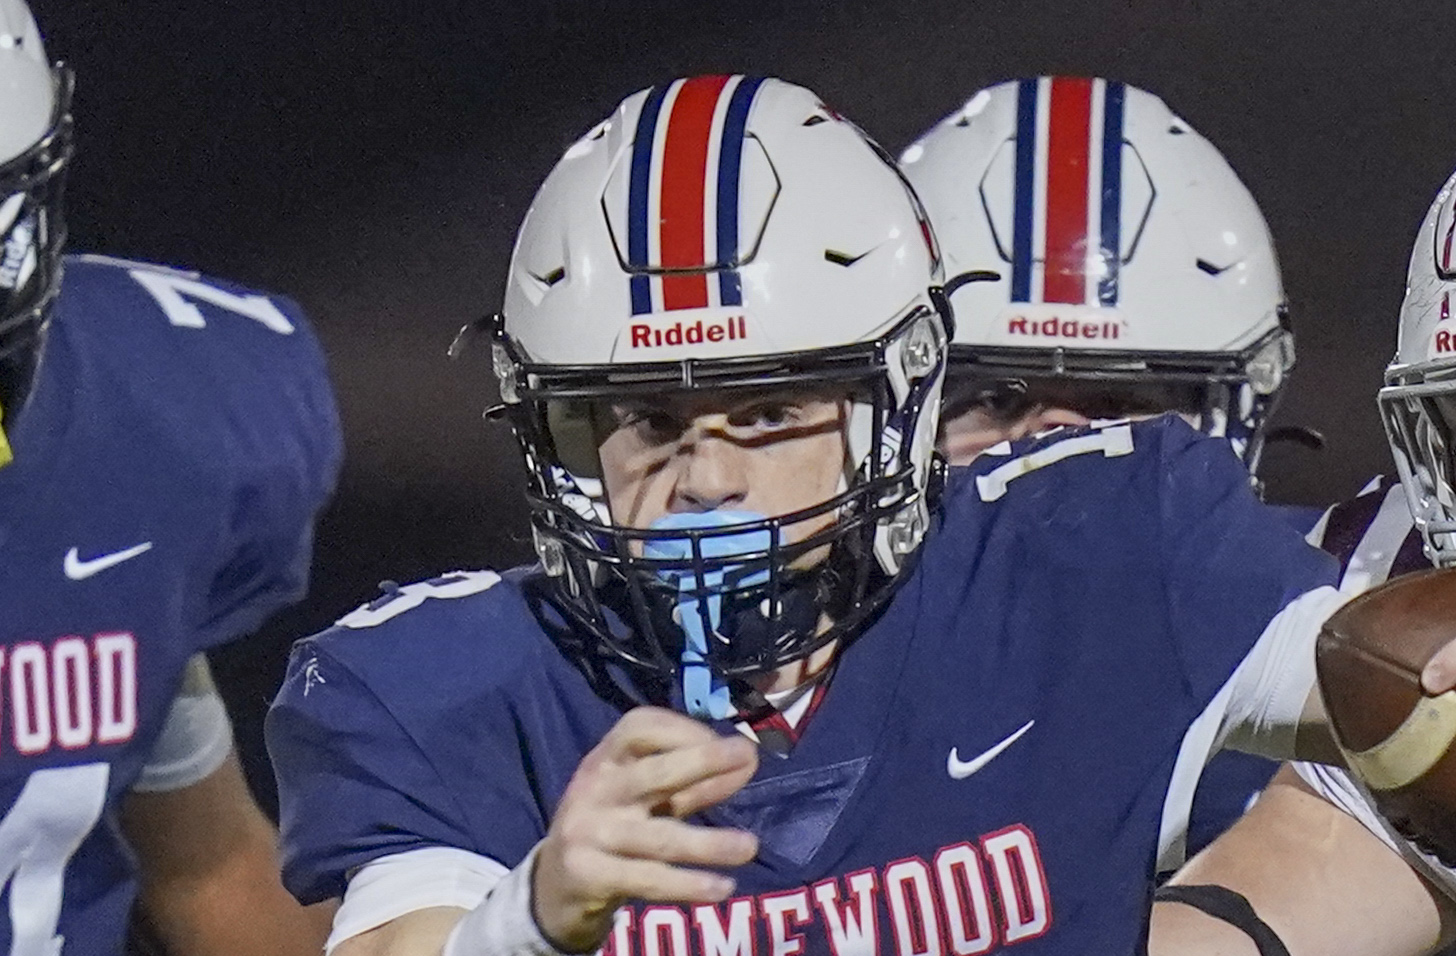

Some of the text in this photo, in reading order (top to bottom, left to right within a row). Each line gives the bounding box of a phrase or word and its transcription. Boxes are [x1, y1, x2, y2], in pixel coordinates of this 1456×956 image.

[631, 316, 746, 348] Riddell
[1008, 316, 1119, 339] Riddell
[0, 631, 138, 755] OOD
